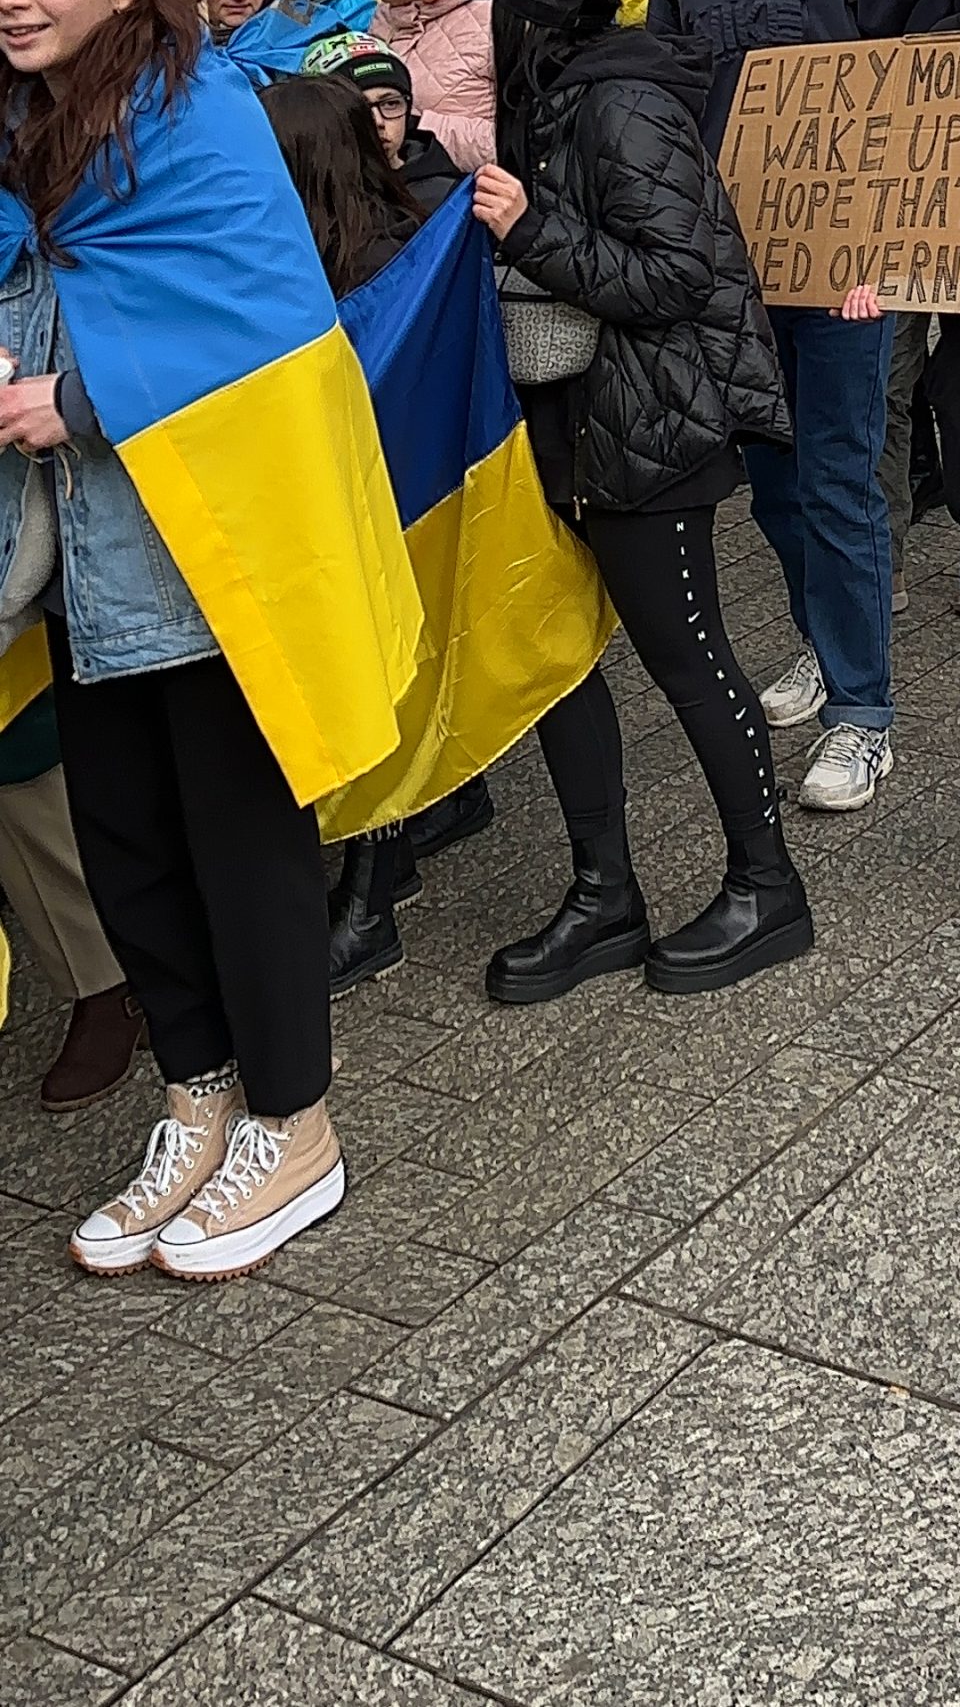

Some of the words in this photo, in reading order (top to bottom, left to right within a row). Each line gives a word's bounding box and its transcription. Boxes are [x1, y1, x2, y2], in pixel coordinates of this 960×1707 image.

[739, 48, 899, 116] EVERY
[728, 124, 744, 177] I
[763, 113, 892, 173] WAKE
[755, 177, 856, 232] HOPE
